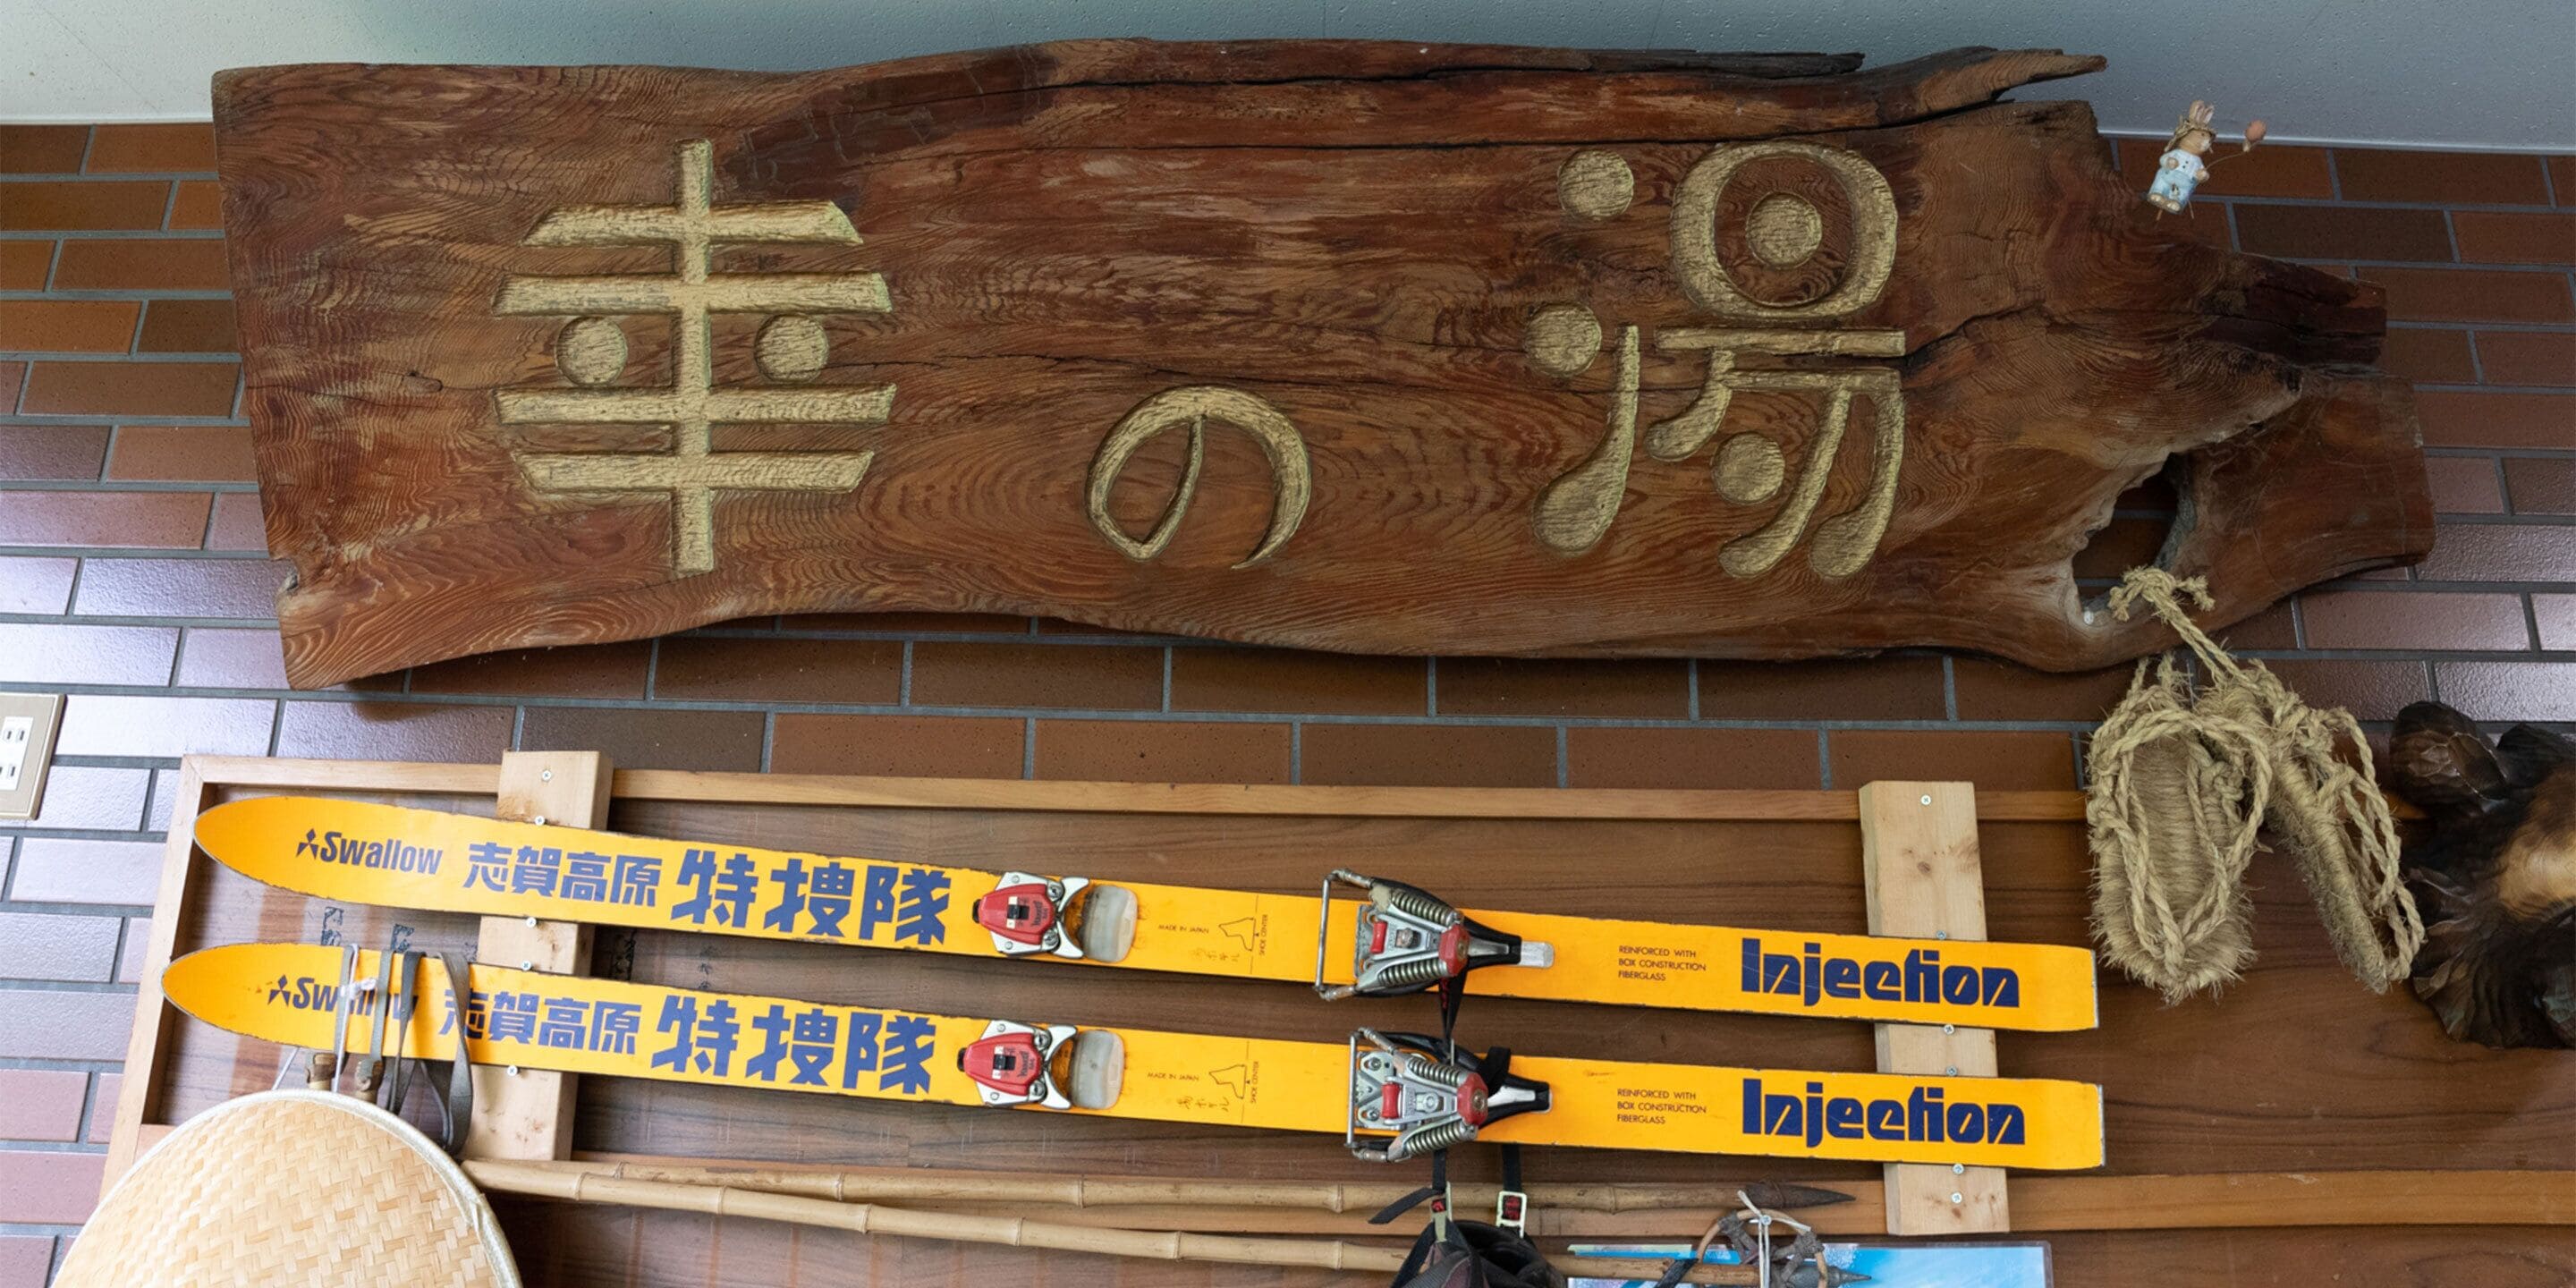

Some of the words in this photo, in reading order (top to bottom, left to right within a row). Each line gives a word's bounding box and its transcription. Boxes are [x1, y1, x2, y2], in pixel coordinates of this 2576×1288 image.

[320, 832, 444, 875] Swallow
[463, 842, 664, 908] 志賀高原
[671, 849, 952, 945] 特捜隊
[1618, 945, 1670, 957] REINFORCED
[1674, 948, 1697, 958] WITH
[1618, 958, 1636, 967] BOX
[1639, 959, 1707, 971] CONSTRUCTION
[1618, 970, 1665, 981] FIBERGLASS
[1741, 937, 2020, 1008] Injection
[438, 987, 642, 1055] 志賀高原
[651, 995, 936, 1095] 特捜隊
[1617, 1088, 1669, 1099] REINFORCED
[1674, 1091, 1697, 1100] WITH
[1617, 1101, 1635, 1110] BOX
[1638, 1102, 1707, 1114] CONSTRUCTION
[1742, 1078, 2025, 1148] Injection
[1617, 1114, 1665, 1124] FIBERGLASS
